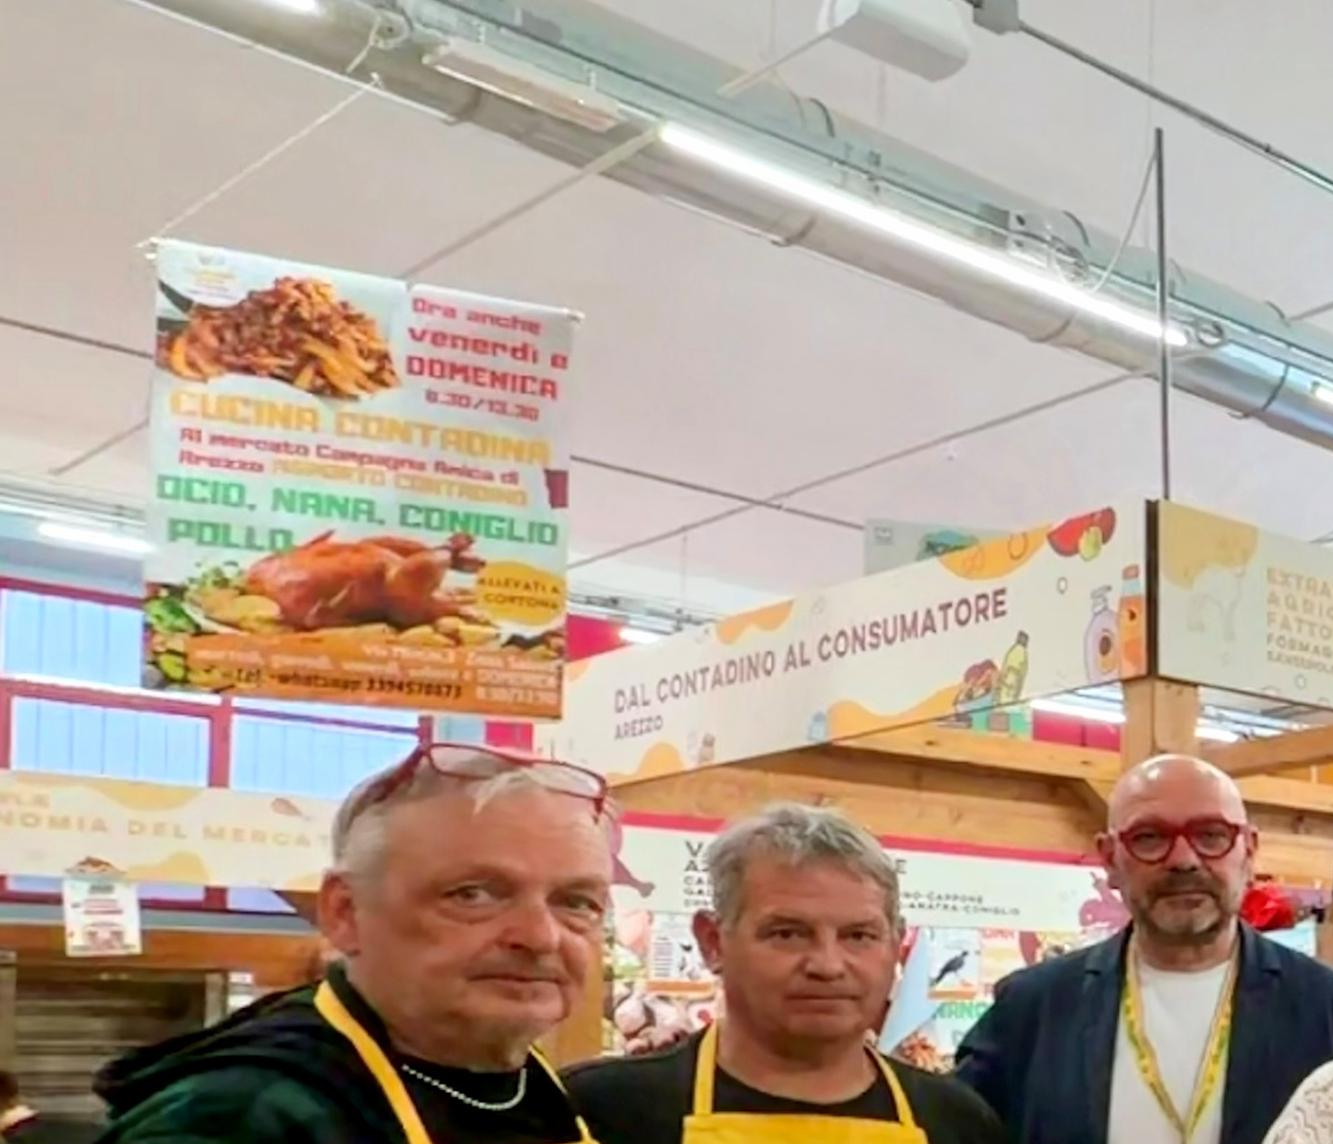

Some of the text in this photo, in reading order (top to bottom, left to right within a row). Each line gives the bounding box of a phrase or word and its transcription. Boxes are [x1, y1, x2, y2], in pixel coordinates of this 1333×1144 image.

[406, 355, 557, 399] DOMENICA
[169, 390, 552, 465] CUCINA CONTADINA
[167, 517, 294, 552] POLLO
[399, 503, 559, 545] CONIGLIO
[614, 588, 1008, 714] DAL CONTADINO AL CONSUMATORE
[614, 715, 664, 741] AREZZO
[126, 819, 189, 840] DEL
